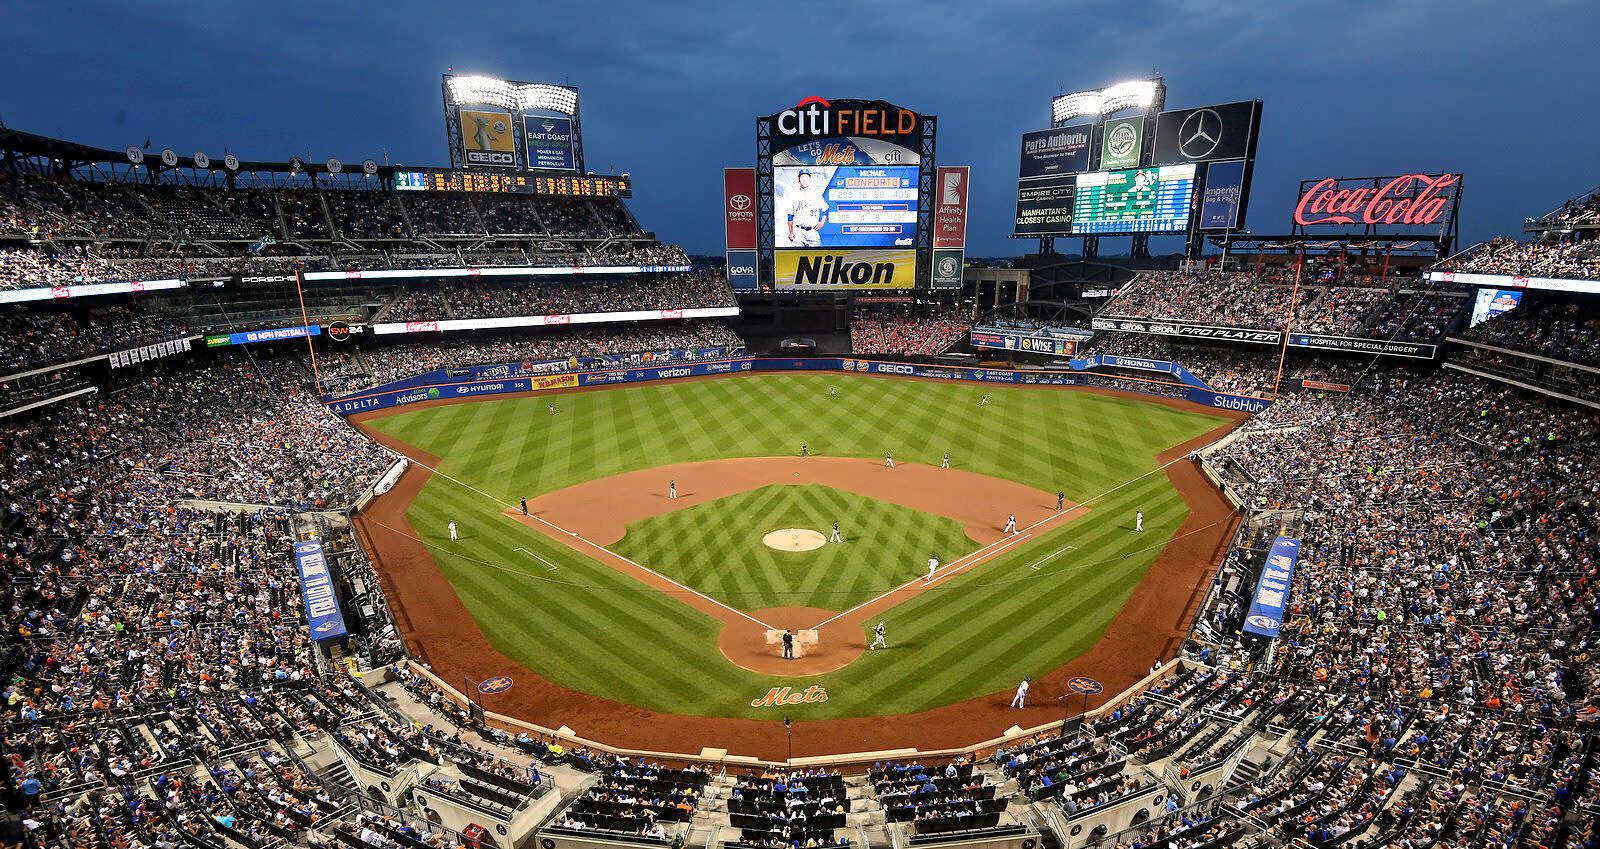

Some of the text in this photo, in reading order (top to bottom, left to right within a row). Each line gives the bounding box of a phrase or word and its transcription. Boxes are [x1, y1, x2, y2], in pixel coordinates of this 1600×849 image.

[778, 103, 916, 135] citi FIELD
[1025, 132, 1088, 151] Parts Authority
[798, 142, 821, 153] LET'S
[810, 148, 822, 157] GO
[130, 150, 140, 159] 31
[166, 152, 174, 161] 41
[468, 152, 512, 163] GEICO
[816, 144, 856, 164] Mets
[884, 150, 900, 162] citi
[1294, 173, 1461, 225] Coca-Cola
[938, 206, 964, 215] Affinity
[1022, 208, 1067, 216] MANHATTAN'S
[1016, 215, 1072, 224] CLOSEST CASINO
[944, 224, 956, 232] Plan
[794, 254, 895, 284] Nikon
[274, 329, 306, 338] FASTBALL
[1180, 327, 1278, 341] PRO PLAYER
[1032, 338, 1052, 352] WISE
[1310, 338, 1338, 346] HOSPITAL
[1354, 342, 1382, 350] SPECIAL
[1384, 344, 1418, 354] SURGERY
[878, 364, 914, 374] GEICO
[1124, 360, 1156, 368] HONDA
[658, 367, 691, 378] verizon
[470, 383, 504, 392] HYUNDAI
[345, 398, 380, 411] DELTA
[396, 393, 428, 405] Advisors
[1214, 396, 1264, 412] StubHub
[751, 685, 829, 708] Mets
